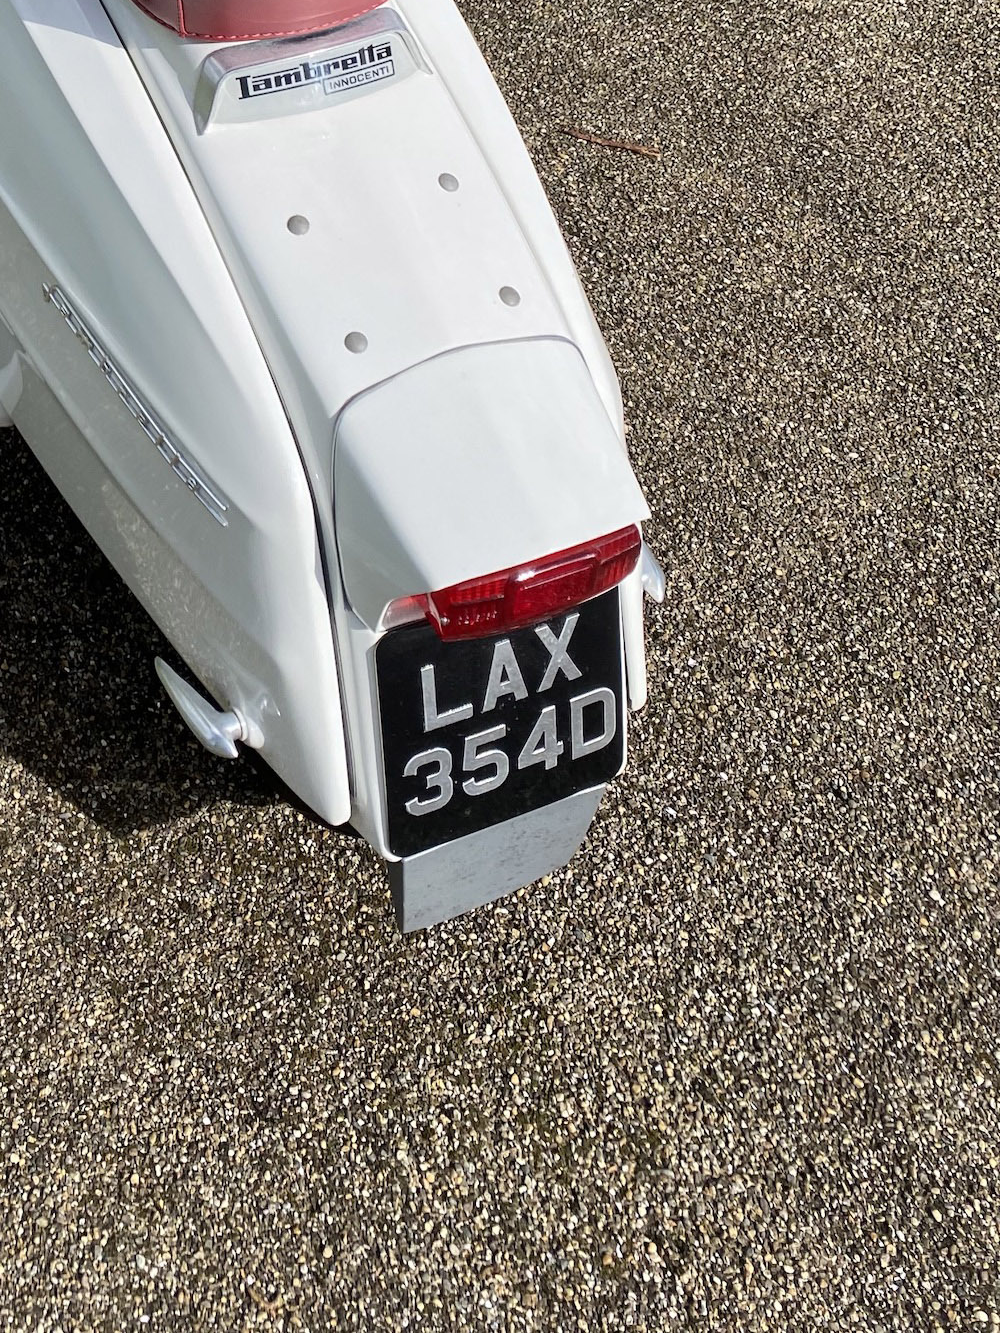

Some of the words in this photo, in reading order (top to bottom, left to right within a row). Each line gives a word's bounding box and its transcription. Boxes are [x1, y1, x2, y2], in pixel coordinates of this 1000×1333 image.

[235, 41, 393, 100] Lambretta
[329, 65, 391, 91] INNOCENTI
[420, 612, 583, 734] LAX
[401, 686, 617, 817] 354D
